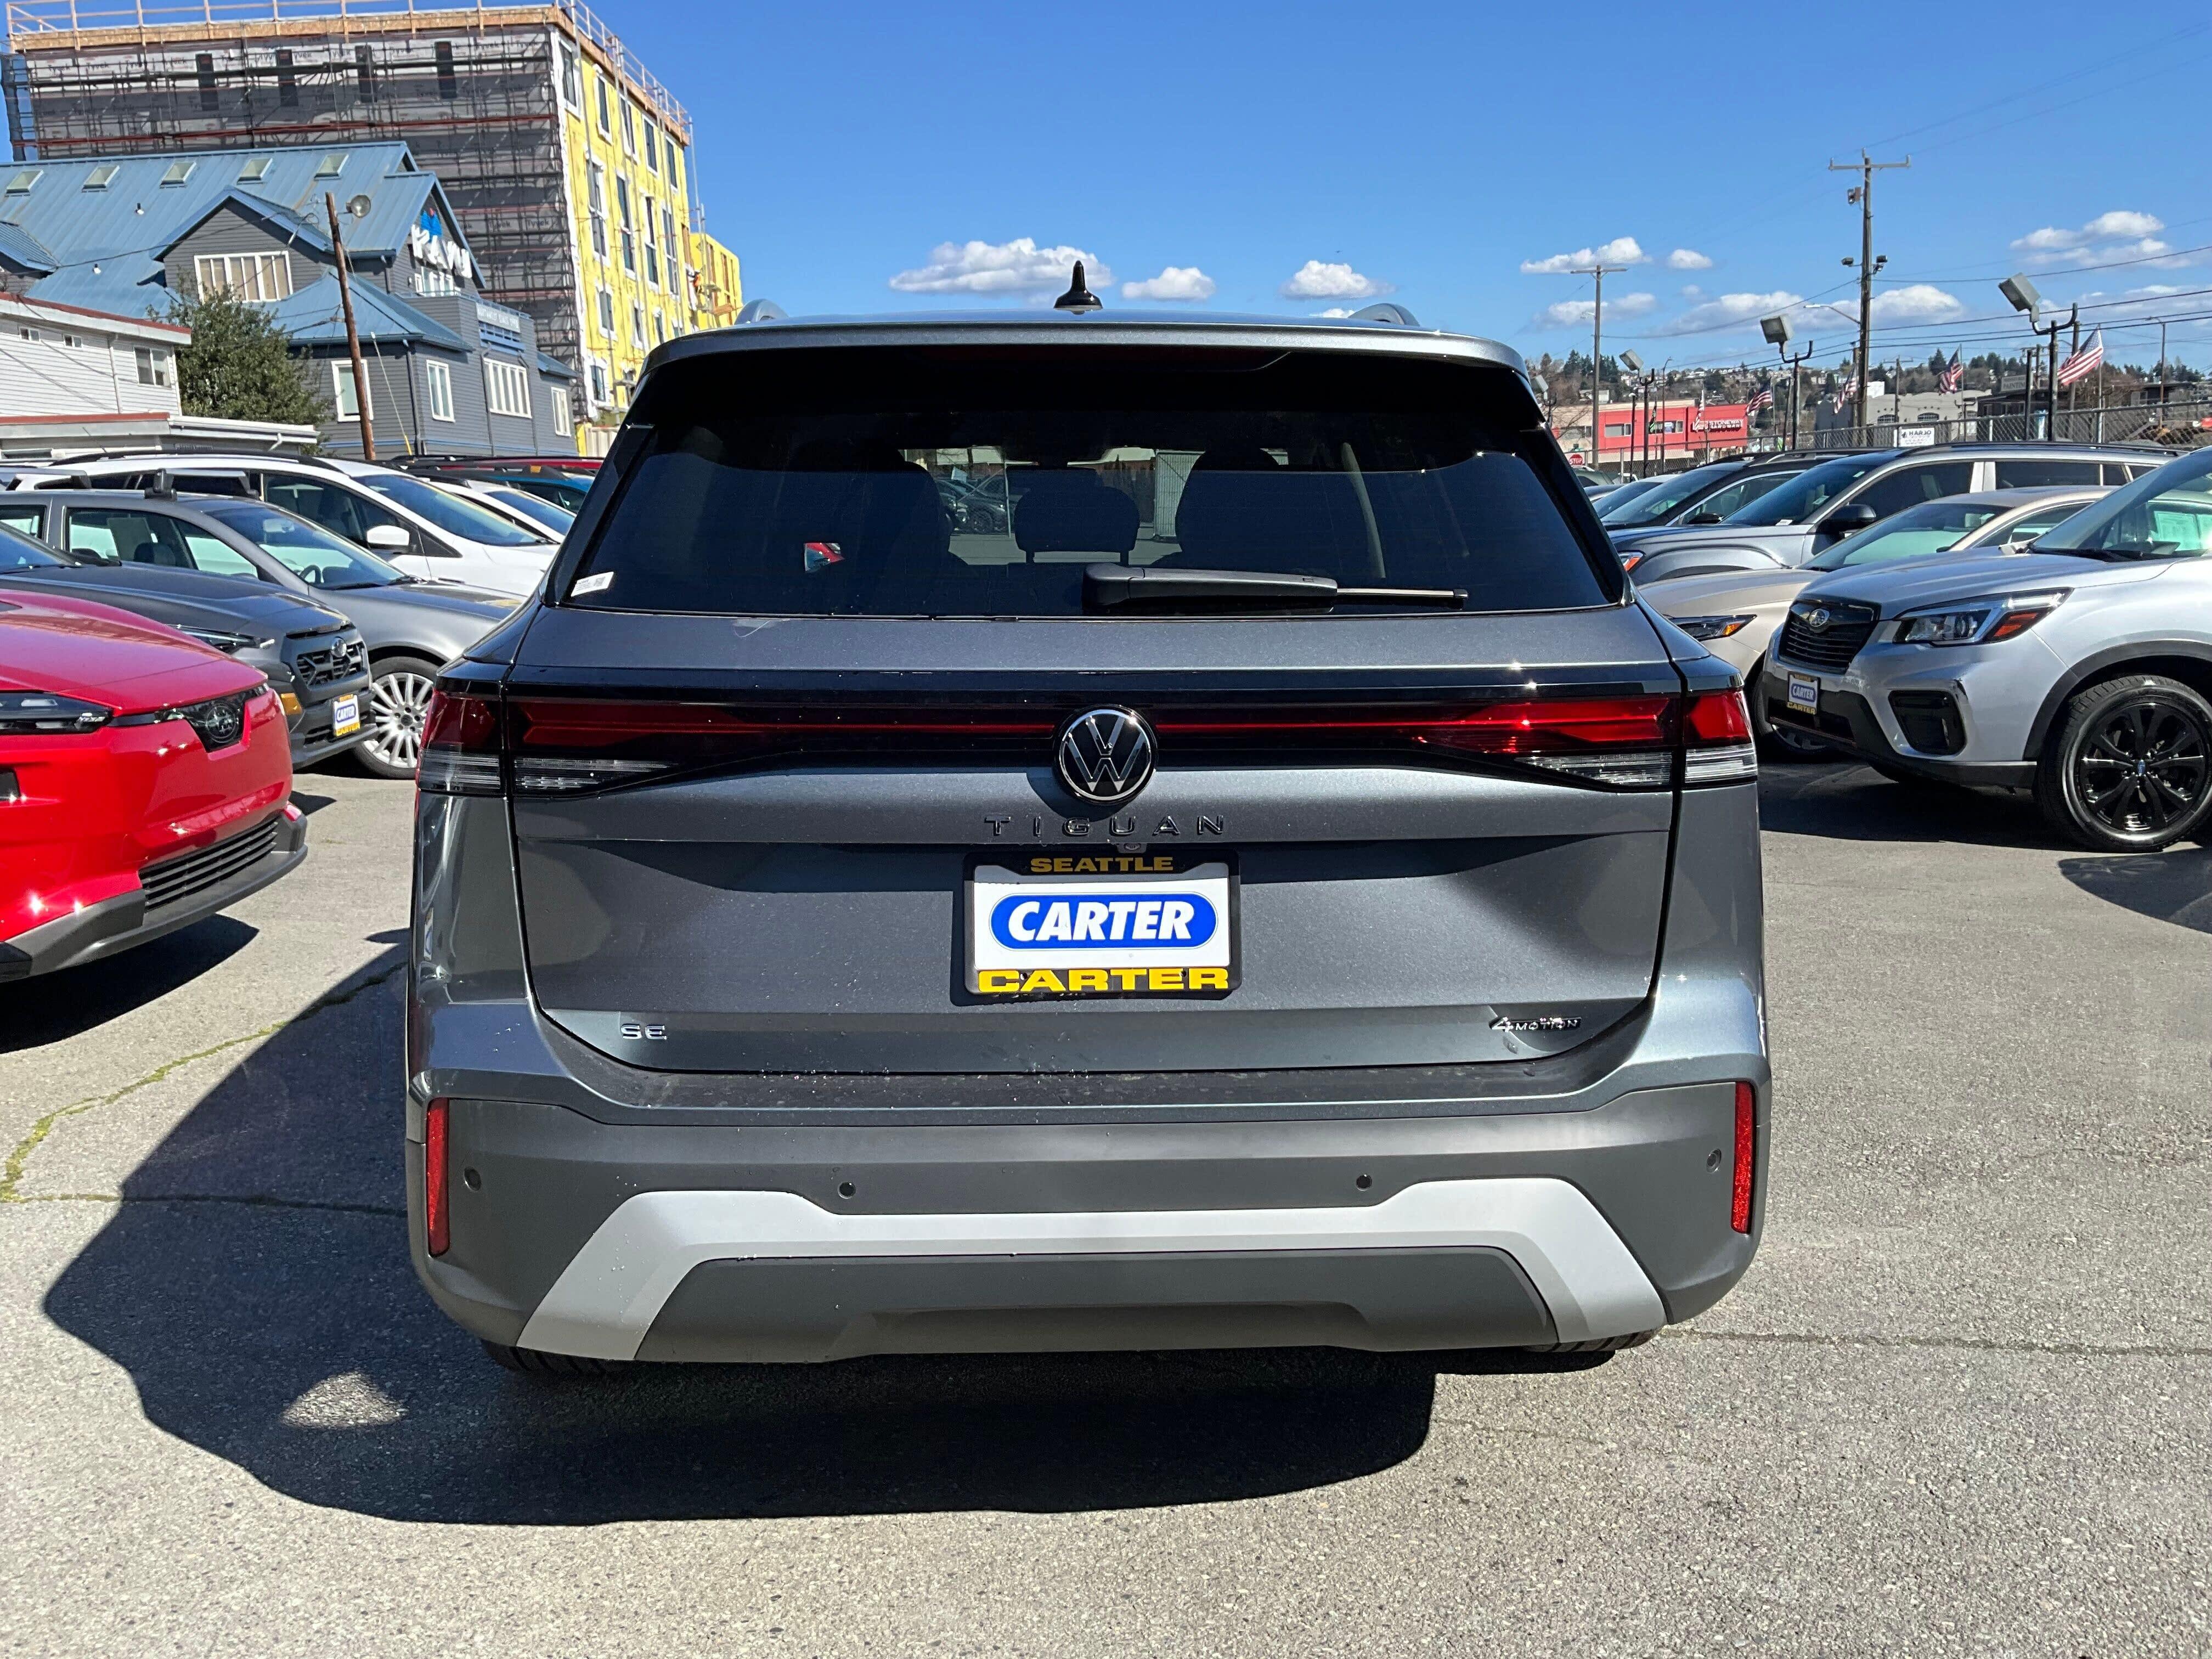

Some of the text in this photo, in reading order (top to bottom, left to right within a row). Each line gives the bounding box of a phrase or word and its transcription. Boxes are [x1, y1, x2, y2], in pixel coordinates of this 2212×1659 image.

[411, 224, 472, 278] KAVU
[2003, 381, 2027, 390] PAINTIN
[1793, 685, 1814, 700] CARTER
[336, 706, 356, 720] CARTER
[1787, 702, 1815, 715] CARTER
[336, 722, 360, 736] CARTER
[984, 815, 1224, 837] TIGUAN
[1030, 856, 1173, 873] SEATTLE
[1008, 900, 1195, 941] CARTER
[978, 967, 1228, 993] CARTER
[620, 1024, 667, 1040] SE
[1489, 1016, 1578, 1032] 4MOTION
